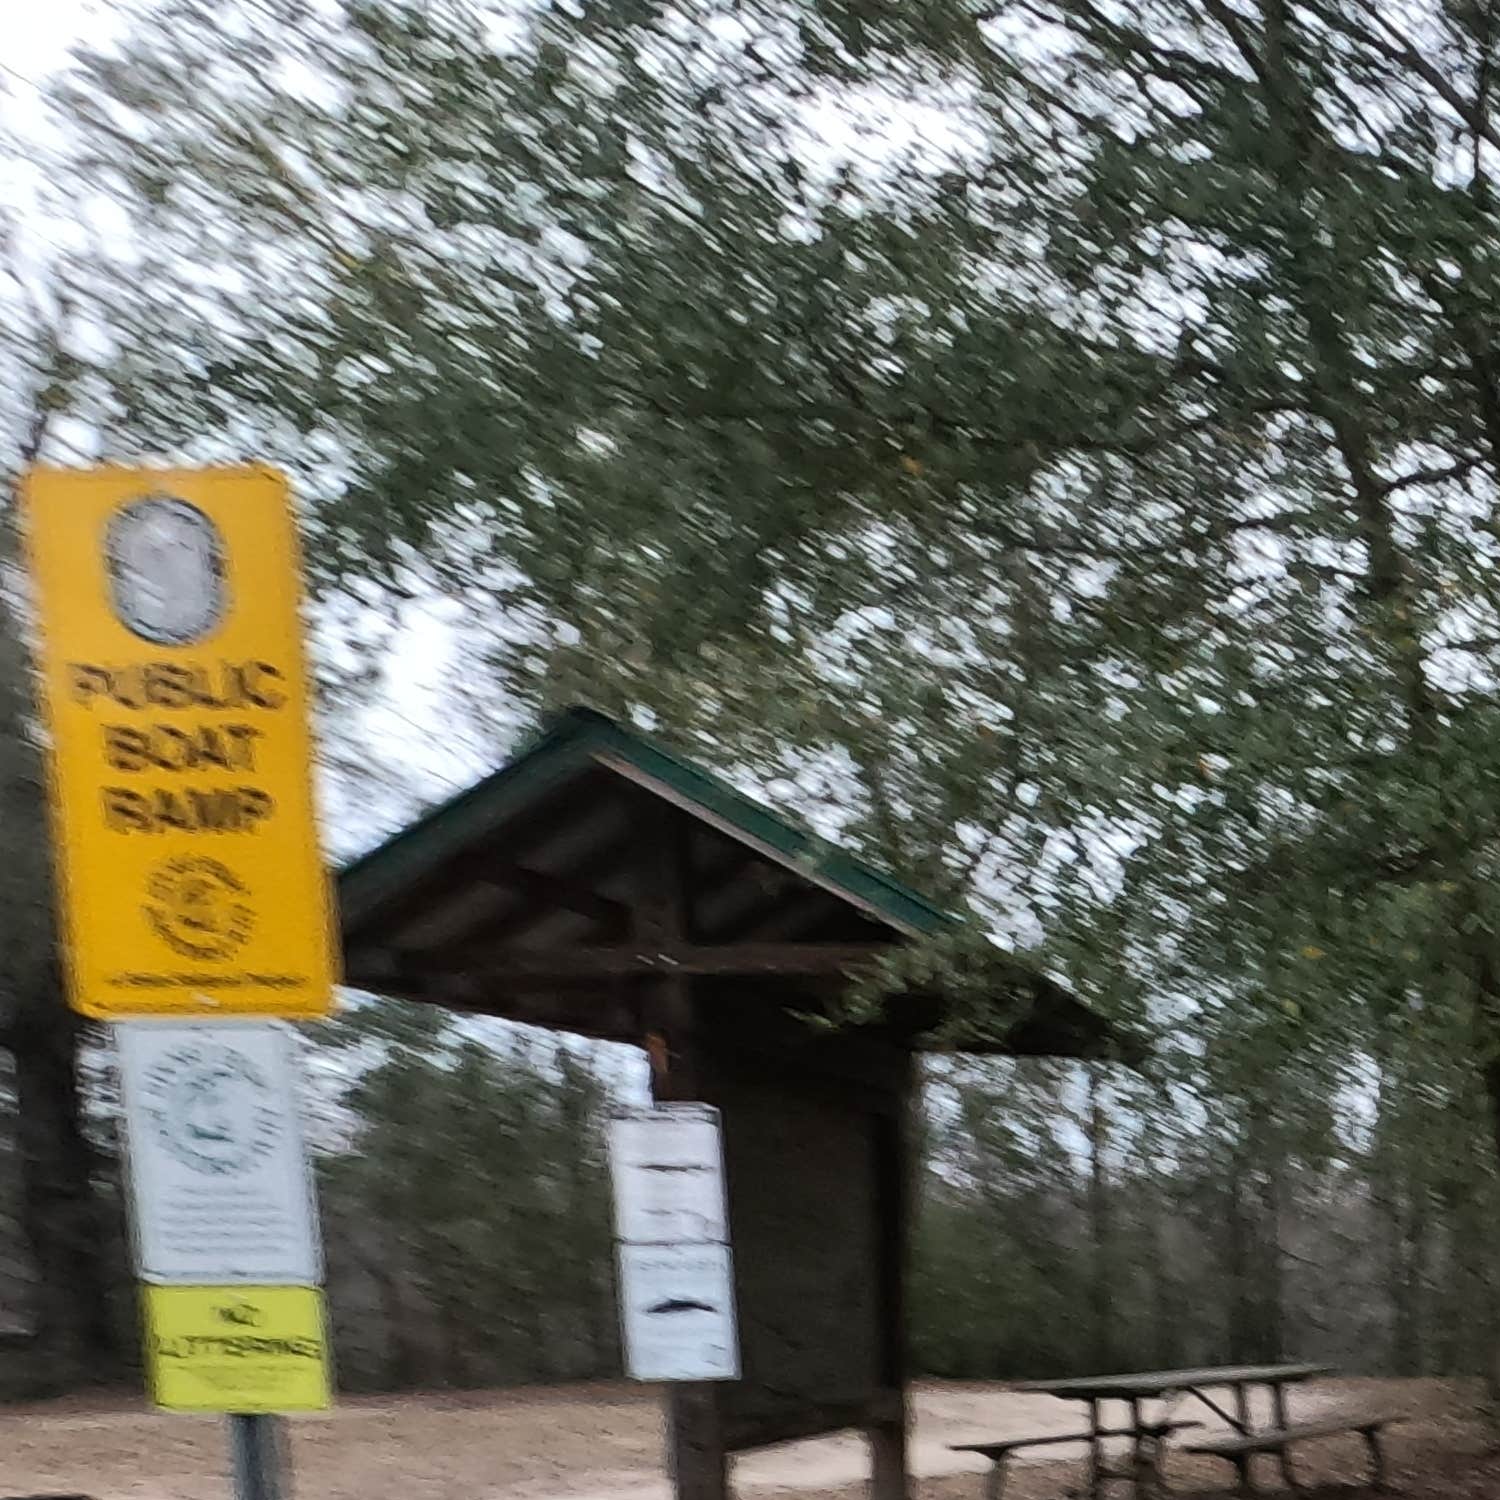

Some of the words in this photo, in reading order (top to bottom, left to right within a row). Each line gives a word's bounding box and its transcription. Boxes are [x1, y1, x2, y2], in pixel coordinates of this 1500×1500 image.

[69, 660, 287, 710] PUBLIC
[103, 724, 263, 773] BOAT
[103, 786, 275, 835] RAMP
